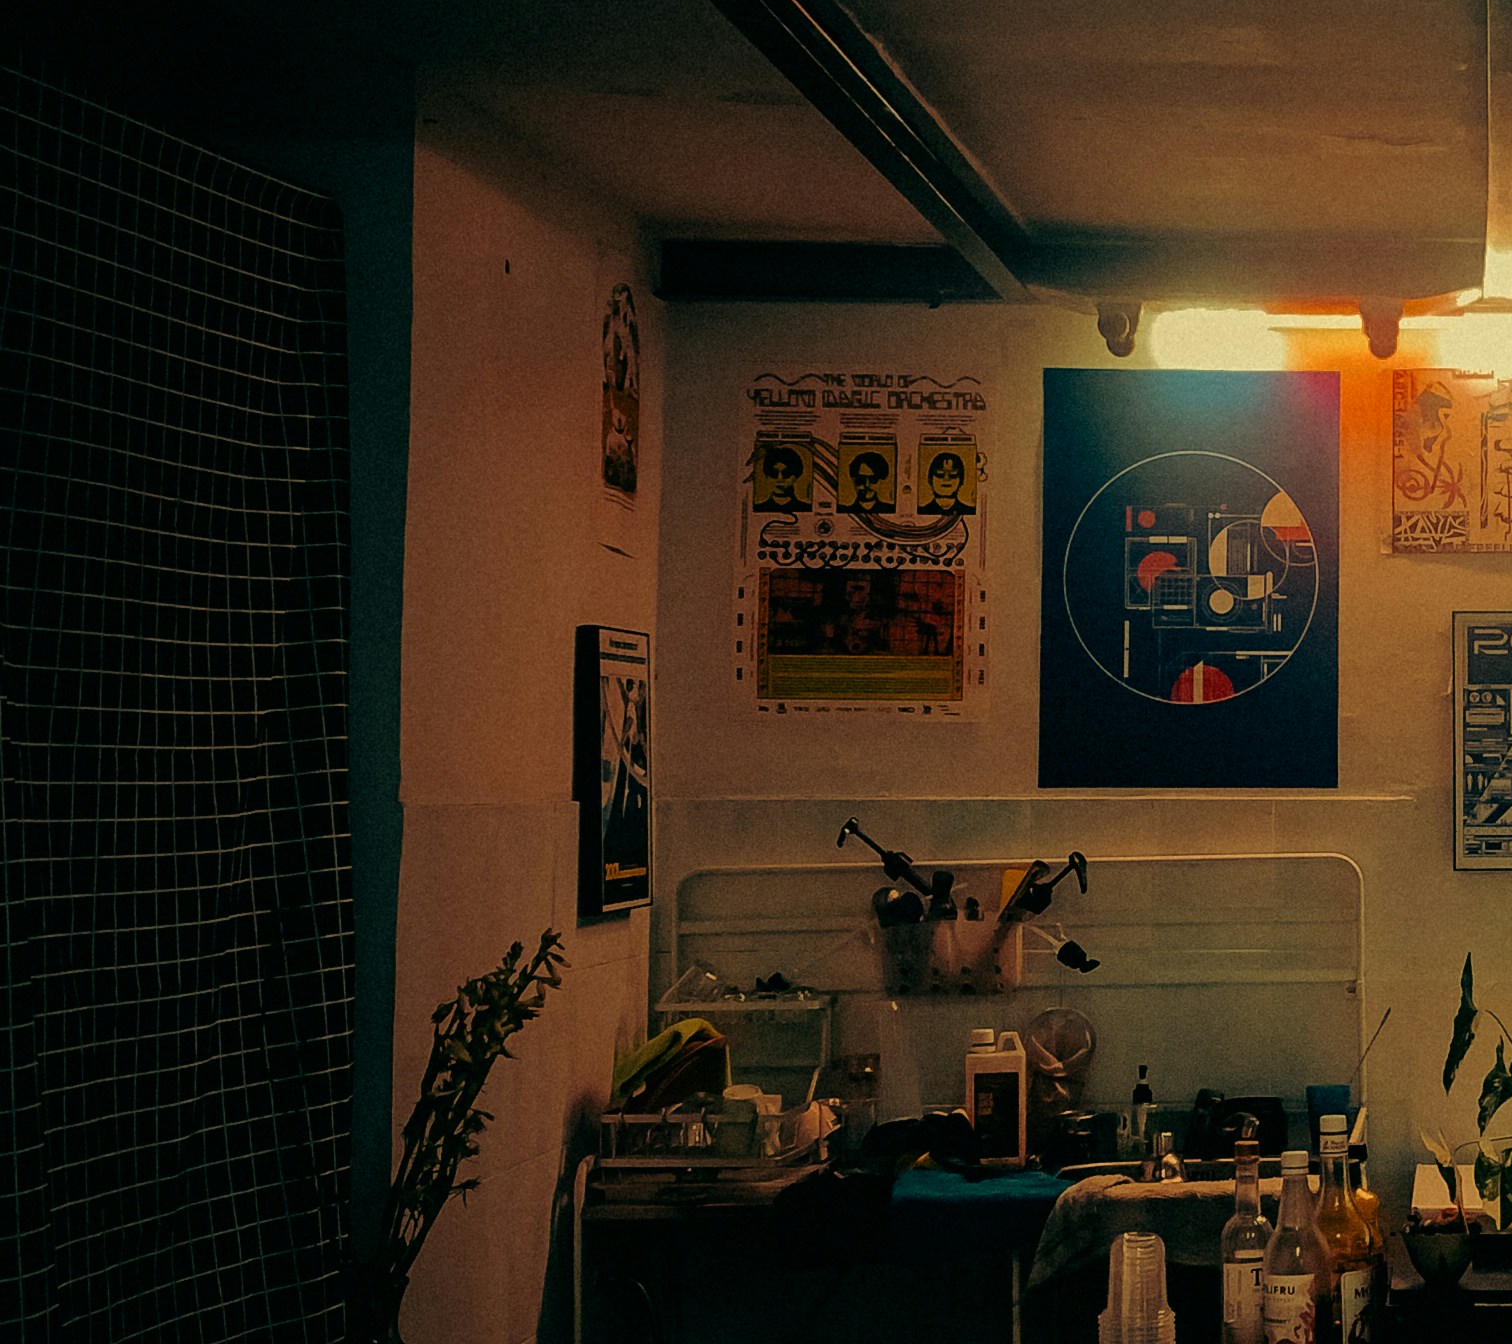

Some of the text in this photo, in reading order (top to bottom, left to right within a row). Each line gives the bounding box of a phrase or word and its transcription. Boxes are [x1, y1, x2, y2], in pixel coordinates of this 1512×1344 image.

[747, 389, 987, 410] YELLOW MAGIC ORCHESTRA
